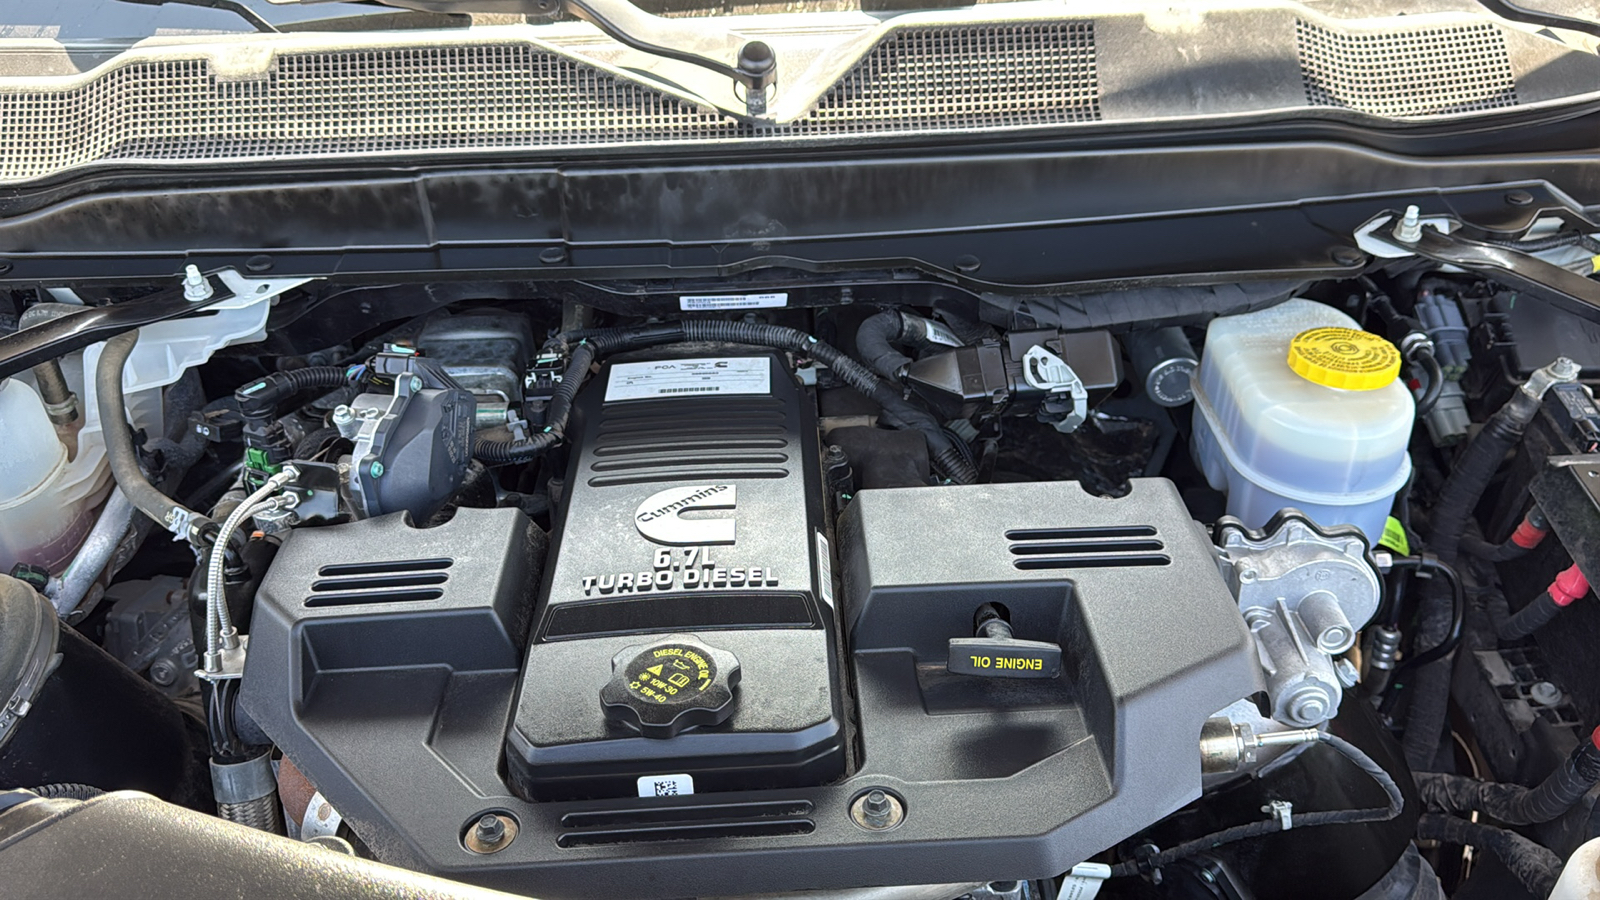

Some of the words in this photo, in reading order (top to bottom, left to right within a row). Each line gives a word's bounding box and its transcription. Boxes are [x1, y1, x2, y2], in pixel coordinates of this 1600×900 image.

[636, 484, 728, 523] Cummins
[653, 546, 715, 571] 6.7L
[582, 569, 674, 595] TURBO
[683, 566, 779, 588] DIESEL
[653, 648, 683, 658] DIESEL
[684, 650, 709, 670] ENGINE
[697, 669, 710, 680] OIL
[970, 655, 991, 668] OIL
[995, 657, 1043, 670] ENGINE
[640, 686, 667, 703] 5W-40
[649, 678, 678, 695] 10W-30
